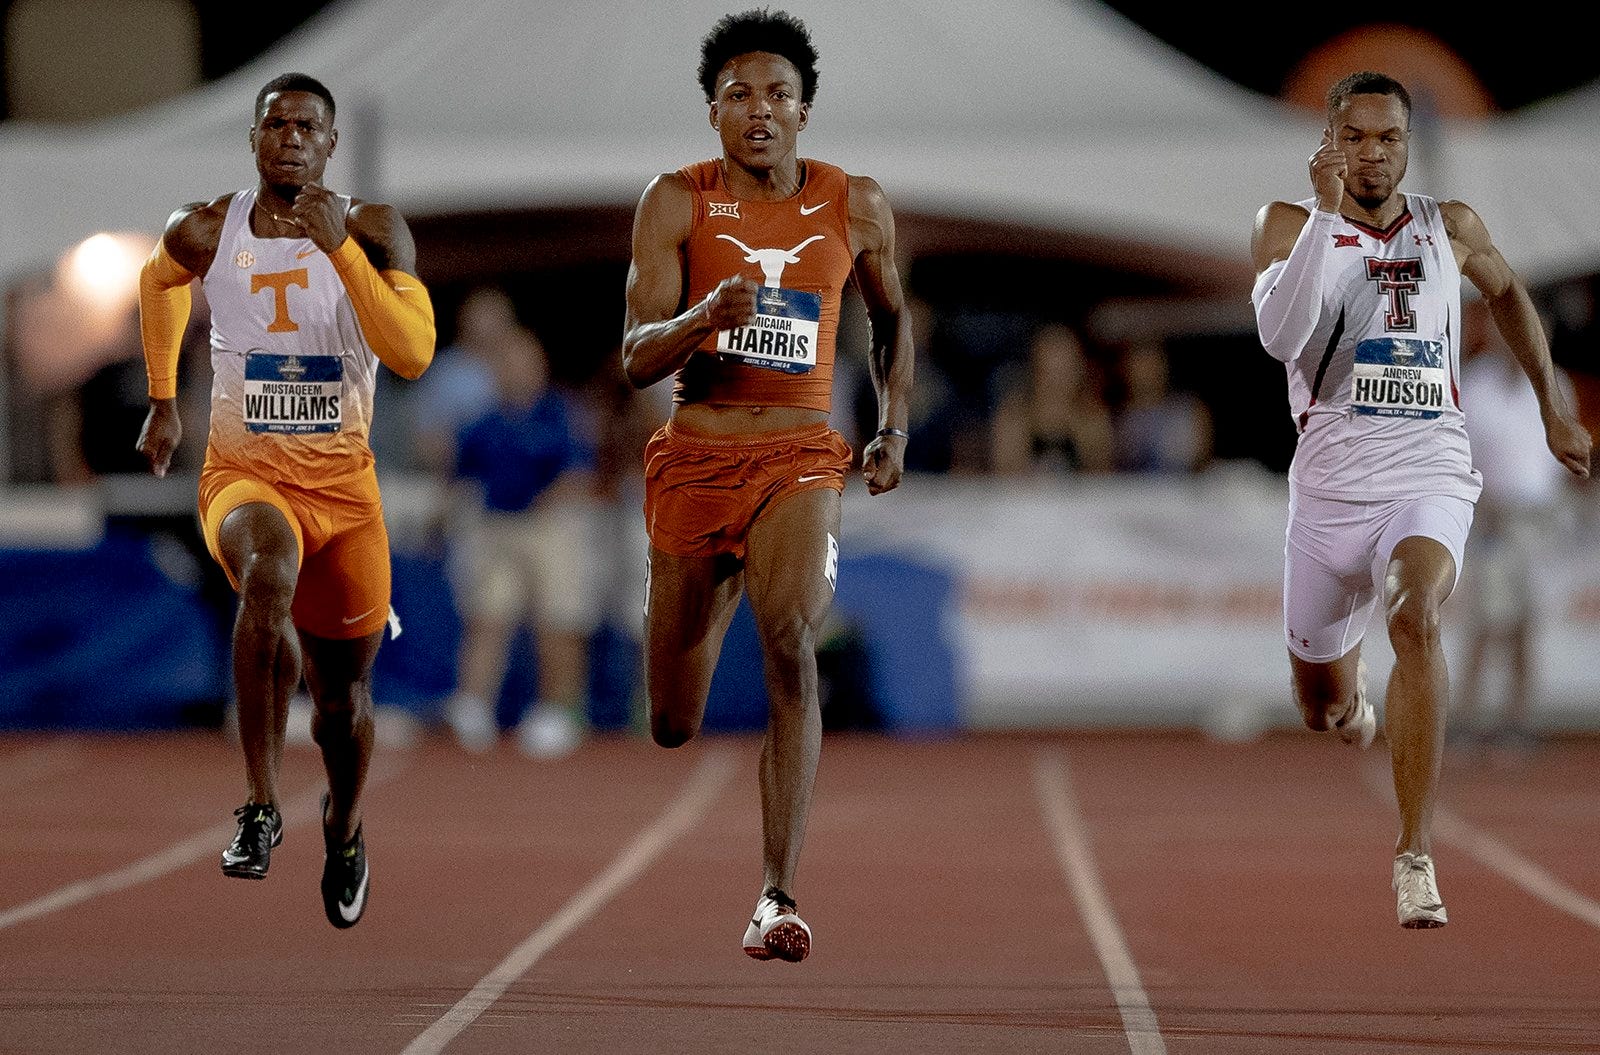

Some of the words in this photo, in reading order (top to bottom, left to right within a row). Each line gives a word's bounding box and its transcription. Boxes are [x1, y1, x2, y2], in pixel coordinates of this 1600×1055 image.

[250, 268, 309, 333] T
[752, 316, 792, 331] MICAIAH
[727, 327, 809, 359] HARRIS
[1382, 367, 1422, 380] ANDREW
[262, 383, 323, 396] MUSTAQEEM
[1355, 378, 1443, 407] HUDSON
[245, 394, 339, 420] WILLIAMS
